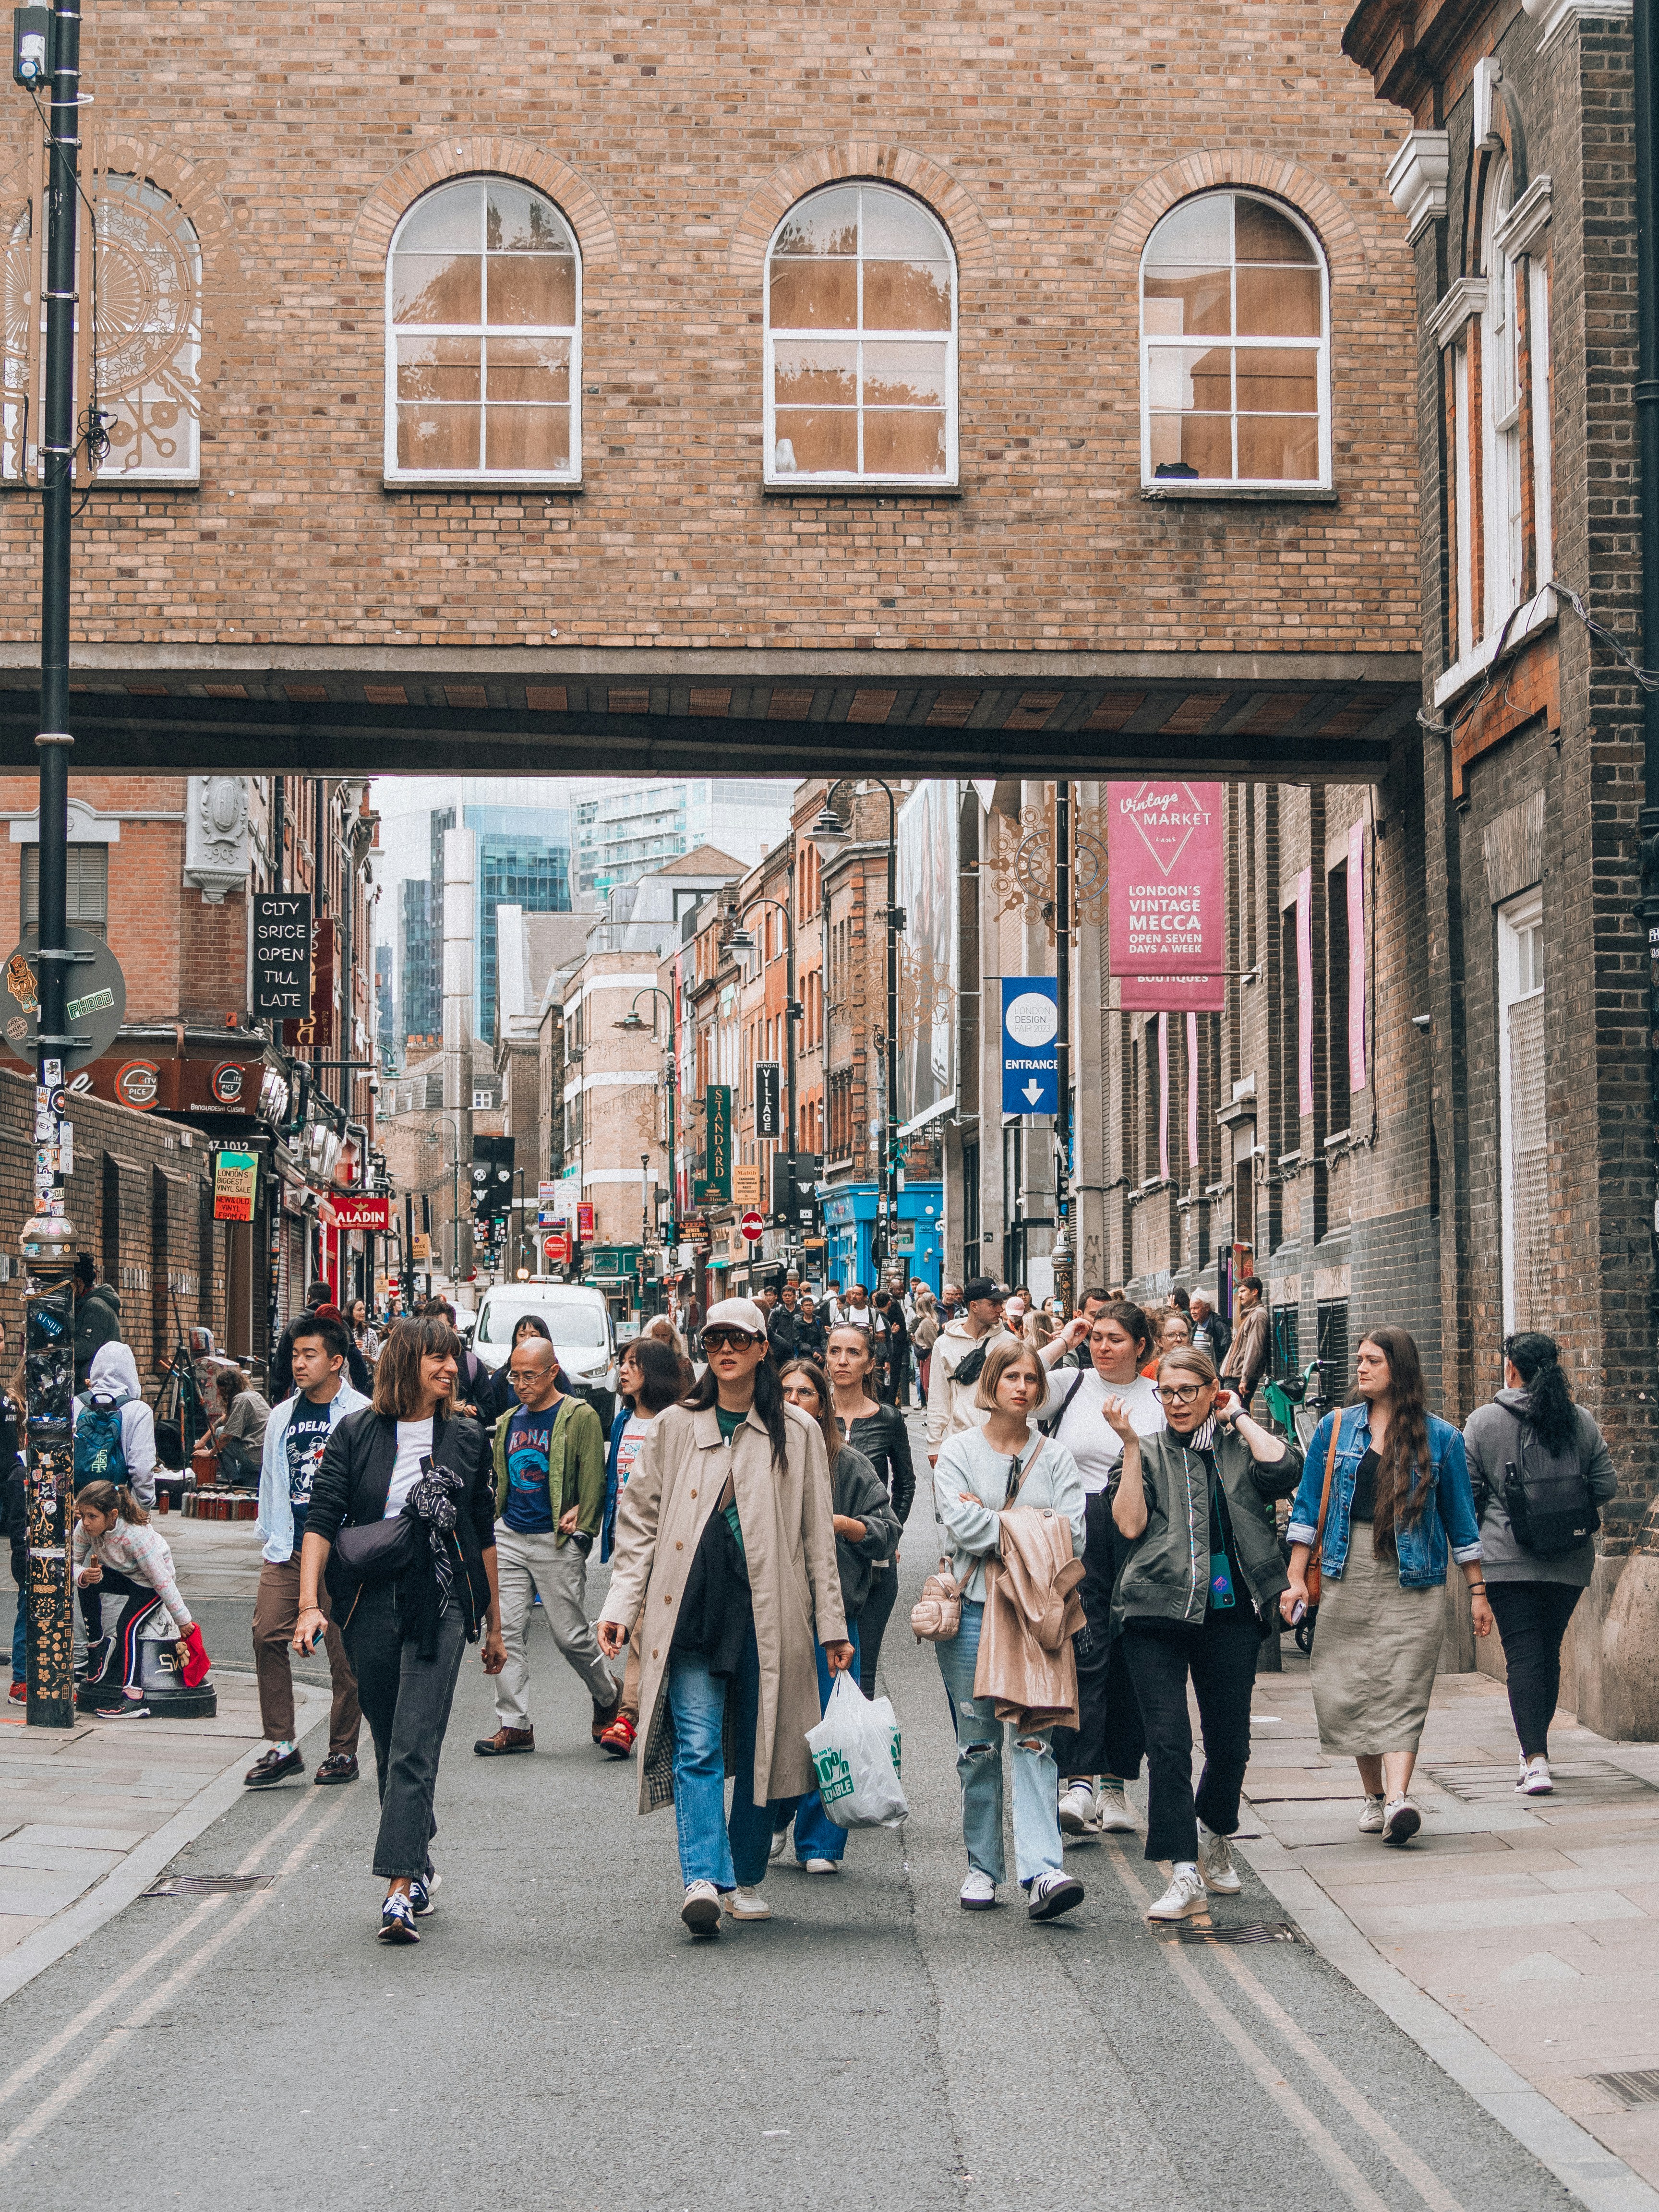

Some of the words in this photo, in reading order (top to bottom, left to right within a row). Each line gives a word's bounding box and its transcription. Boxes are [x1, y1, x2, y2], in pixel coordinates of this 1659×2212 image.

[1120, 792, 1178, 814] Vintage
[1143, 813, 1211, 826] MARKET
[207, 847, 236, 863] 1903
[1129, 885, 1201, 896] LONDON'S
[262, 902, 299, 916] CITY
[1129, 900, 1201, 912] VINTAGE
[1129, 915, 1201, 930] MECCA
[258, 925, 306, 938] SPICE
[1129, 934, 1161, 943] OPEN
[1165, 934, 1202, 943] SEVEN
[258, 948, 303, 961] OPEN
[1129, 945, 1157, 953] DAYS
[1160, 945, 1168, 953] A
[1171, 944, 1202, 953] WEEK
[264, 970, 299, 984] TILL
[68, 991, 113, 1020] PHOOD
[261, 994, 301, 1007] LATE
[1014, 1007, 1051, 1015] LONDON
[8, 1022, 26, 1034] BRKS
[1014, 1024, 1032, 1033] FAIR
[1034, 1024, 1051, 1033] 2023
[1005, 1059, 1058, 1070] ENTRANCE
[123, 1086, 146, 1095] SPICE
[762, 1069, 772, 1131] VILLAGE
[714, 1089, 724, 1177] STANDARD
[216, 1177, 243, 1186] BIGGEST
[216, 1184, 234, 1192] VINYL
[235, 1186, 252, 1194] SALE
[221, 1204, 241, 1213] VINYL
[337, 1212, 385, 1223] ALADIN
